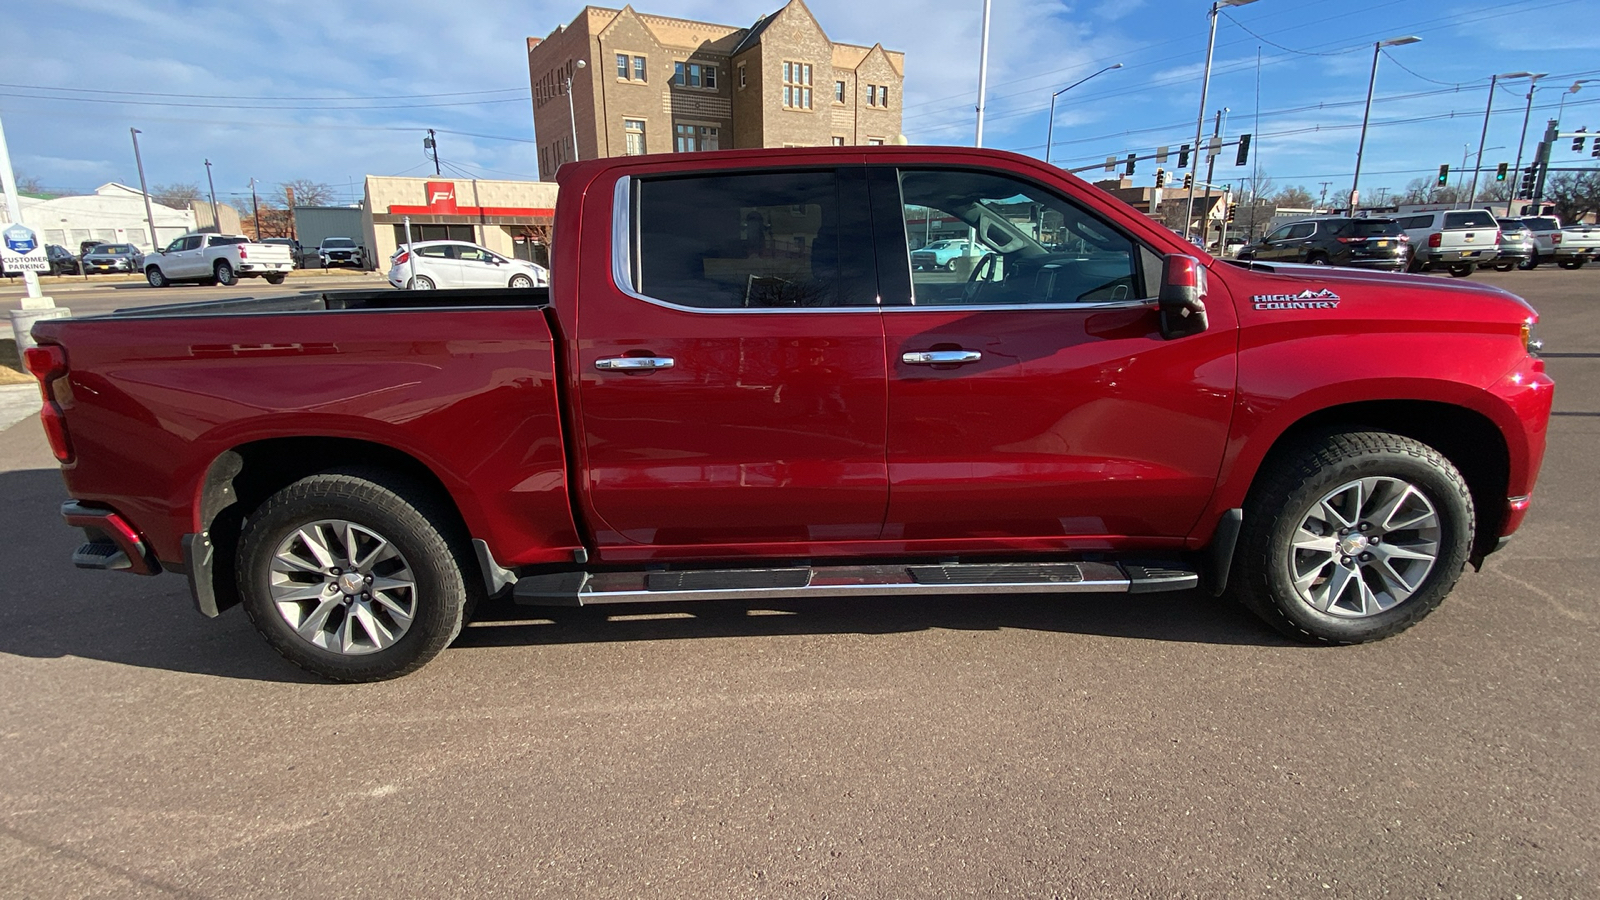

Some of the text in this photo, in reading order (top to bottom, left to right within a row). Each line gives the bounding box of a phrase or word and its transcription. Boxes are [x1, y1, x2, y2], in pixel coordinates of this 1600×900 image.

[3, 256, 49, 264] CUSTOMER
[1252, 294, 1298, 302] HIGH
[1254, 301, 1340, 310] COUNTRY
